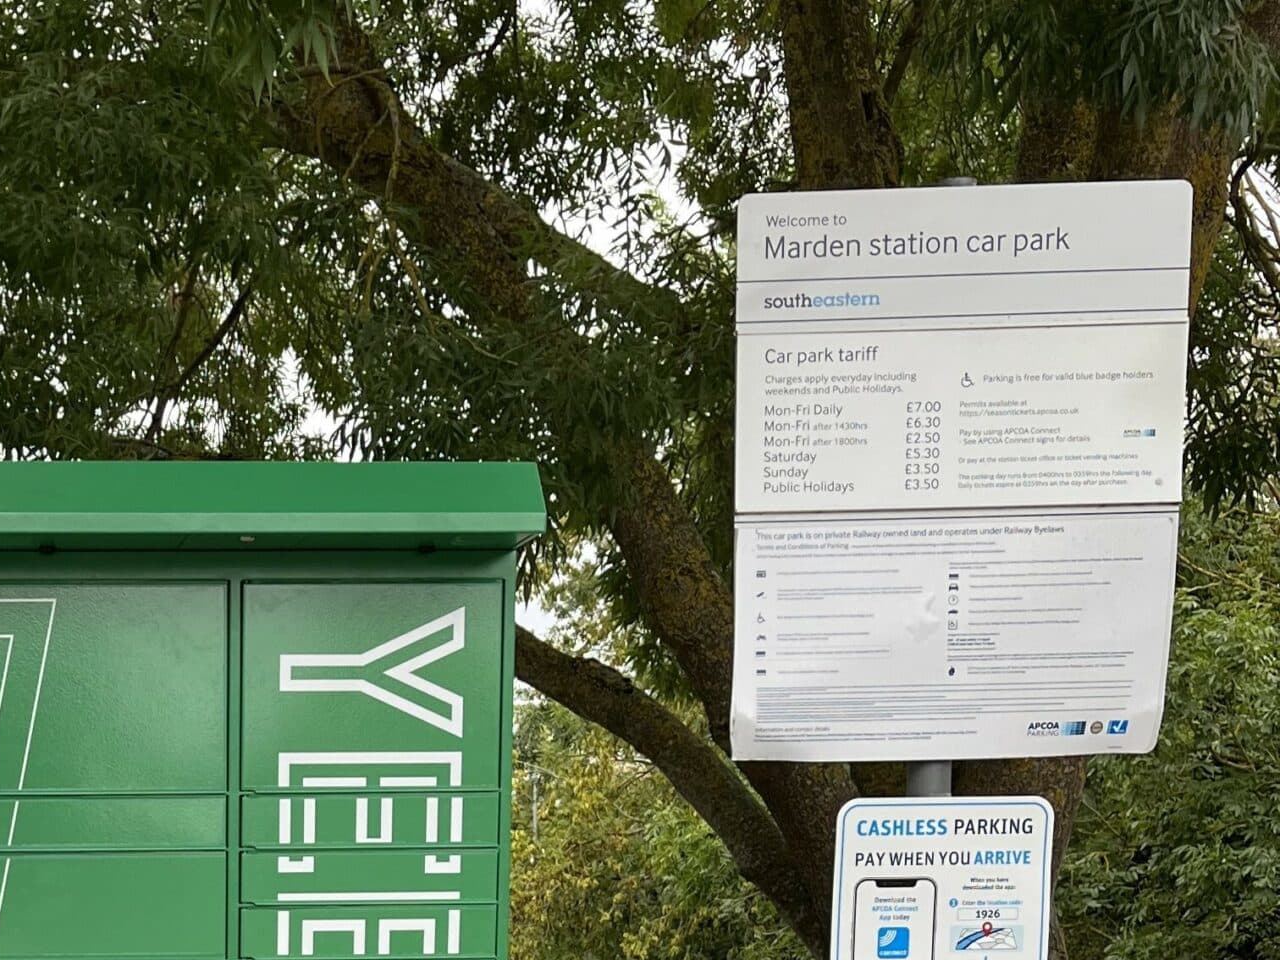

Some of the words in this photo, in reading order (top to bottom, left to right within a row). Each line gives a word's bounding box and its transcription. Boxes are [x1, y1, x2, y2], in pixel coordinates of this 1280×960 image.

[766, 214, 828, 228] Welcome
[833, 214, 847, 226] to
[765, 234, 861, 259] Marden
[870, 231, 958, 256] station
[966, 232, 1006, 253] car
[1014, 227, 1069, 256] park
[764, 292, 880, 309] southeastern
[765, 349, 792, 363] Car
[798, 348, 833, 366] park
[839, 346, 878, 361] tariff
[765, 375, 802, 385] Charges
[804, 375, 829, 383] apply
[831, 373, 872, 382] everyday
[874, 372, 917, 381] including
[984, 374, 1013, 384] Parking
[1024, 373, 1040, 382] free
[1042, 373, 1053, 381] for
[1055, 373, 1074, 381] valid
[1076, 372, 1093, 380] blue
[1096, 372, 1120, 381] badge
[1123, 371, 1153, 379] holders
[765, 386, 811, 395] weekends
[813, 386, 830, 394] and
[833, 385, 860, 393] Public
[764, 405, 809, 416] Mon-Fri
[814, 404, 843, 417] Daily
[907, 401, 941, 413] £7.00
[764, 420, 809, 432] Mon-Fri
[813, 422, 832, 430] after
[835, 422, 867, 430] 1430hrs
[906, 417, 940, 428] £6.30
[764, 436, 809, 447] Mon-Fri
[906, 432, 940, 443] £2.50
[764, 452, 816, 464] Saturday
[906, 447, 940, 459] £5.30
[764, 467, 808, 479] Sunday
[905, 463, 939, 474] £3.50
[764, 482, 800, 493] Public
[804, 481, 854, 493] Holidays
[905, 479, 939, 490] £3.50
[825, 532, 850, 540] private
[853, 531, 881, 539] Railway
[883, 530, 908, 538] owned
[910, 529, 926, 537] land
[945, 529, 980, 537] operates
[1005, 528, 1034, 536] Railway
[1036, 526, 1065, 534] Byelaws
[857, 819, 947, 837] CASHLESS
[954, 818, 1033, 834] PARKING
[855, 852, 885, 867] PAY
[890, 851, 934, 866] WHEN
[939, 851, 971, 865] YOU
[974, 851, 1031, 864] ARRIVE
[976, 909, 1000, 919] 1926
